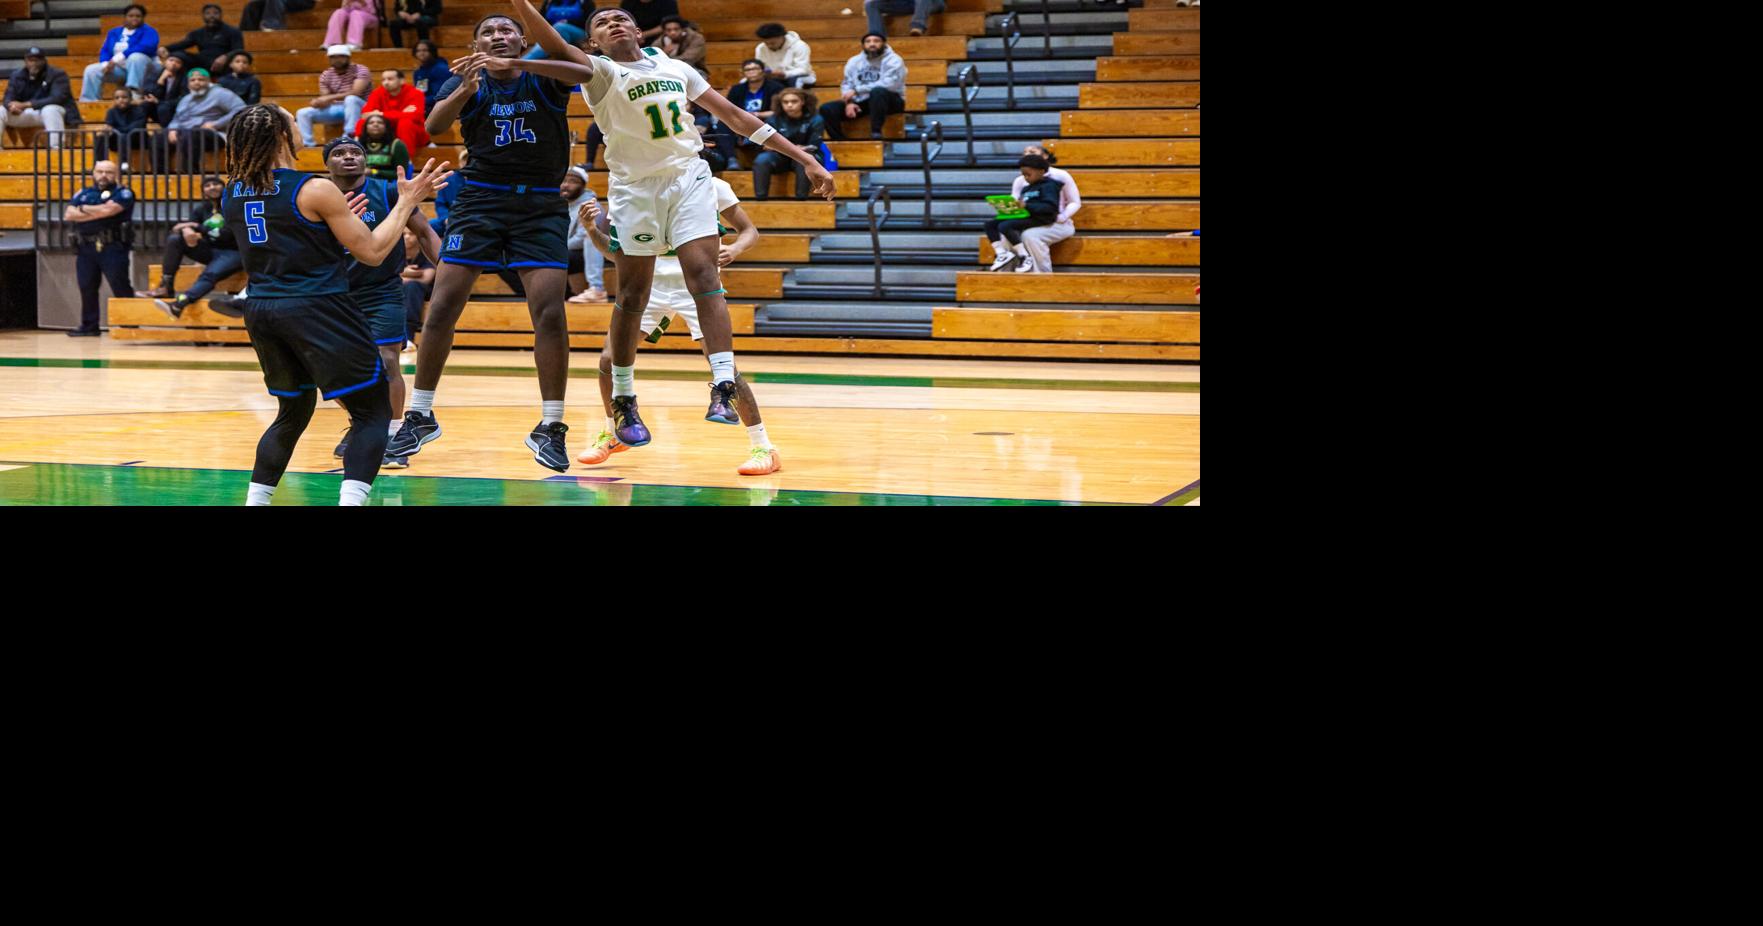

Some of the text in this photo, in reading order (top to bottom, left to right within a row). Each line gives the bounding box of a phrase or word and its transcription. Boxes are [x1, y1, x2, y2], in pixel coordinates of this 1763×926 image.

[627, 80, 685, 101] GRAYSON
[494, 117, 537, 147] 34
[643, 101, 684, 140] 11
[244, 200, 268, 243] 5
[446, 234, 464, 251] N
